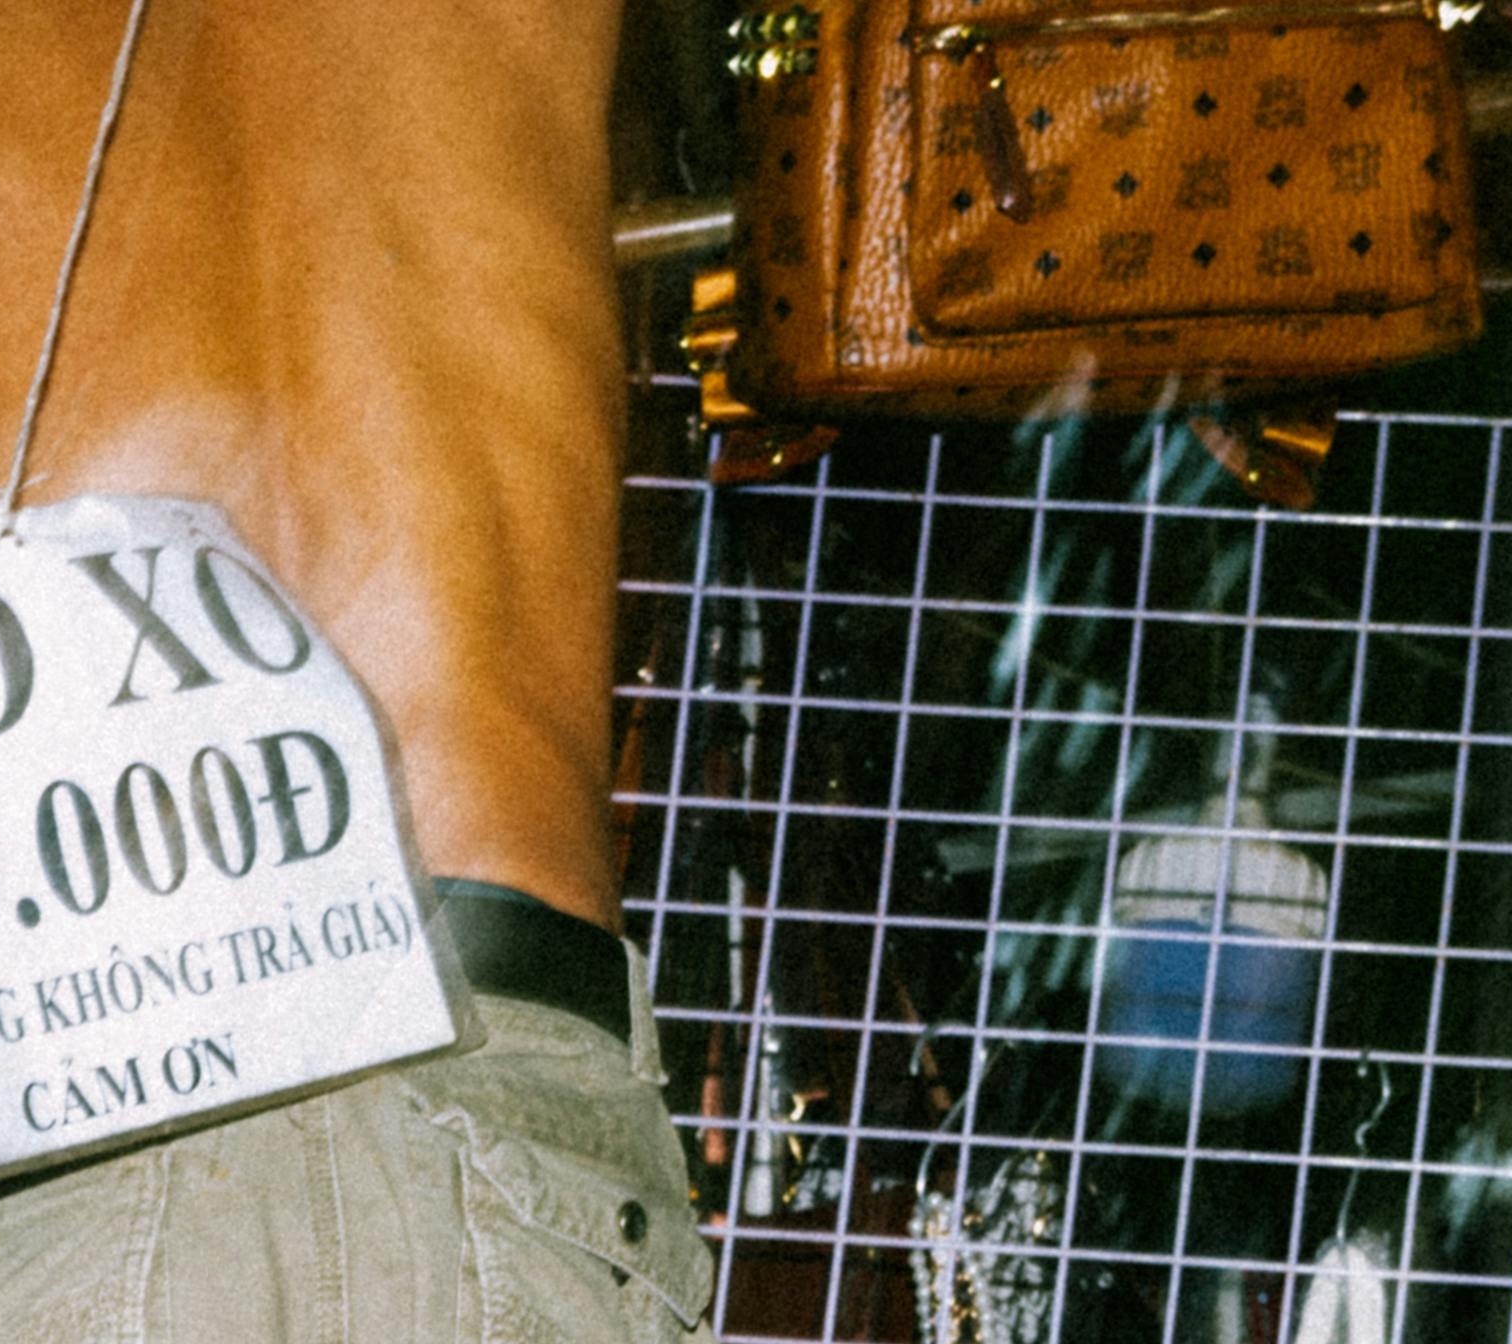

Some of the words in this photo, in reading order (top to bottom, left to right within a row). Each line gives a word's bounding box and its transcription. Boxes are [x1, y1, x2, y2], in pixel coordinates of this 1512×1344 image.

[34, 944, 214, 1035] KHÔNG
[218, 902, 314, 984] TRẢ
[161, 1032, 240, 1096] ƠN
